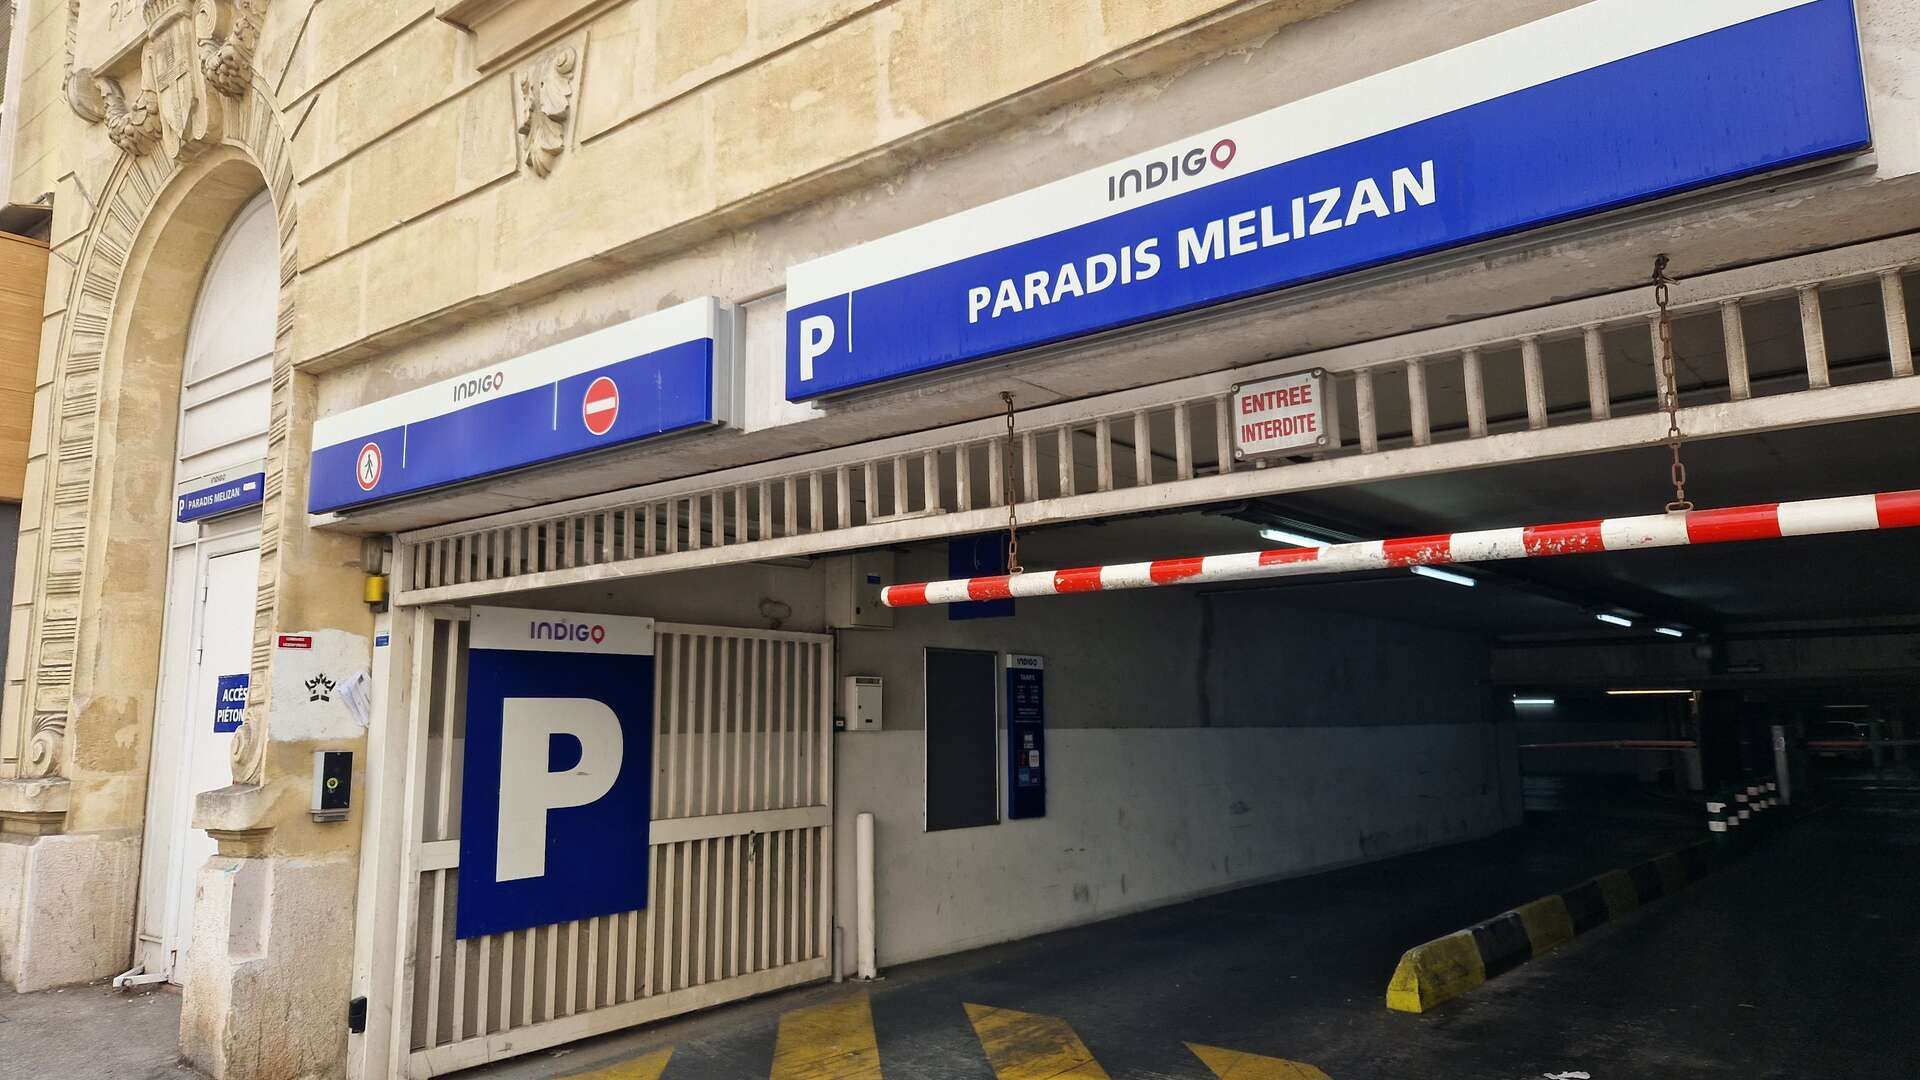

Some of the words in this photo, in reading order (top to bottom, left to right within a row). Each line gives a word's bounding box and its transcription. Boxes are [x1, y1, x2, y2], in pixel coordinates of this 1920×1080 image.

[1108, 138, 1237, 202] INDIGO
[799, 314, 835, 382] P
[968, 237, 1161, 324] PARADIS
[1177, 159, 1436, 269] MELIZAN
[453, 371, 504, 403] INDIGO
[1241, 384, 1313, 415] ENTREE
[1241, 412, 1317, 443] INTERDITE
[179, 499, 184, 516] P
[188, 495, 213, 510] PARADIS
[214, 487, 240, 503] MELIZAN
[530, 621, 605, 645] INDIGO
[496, 697, 624, 883] P
